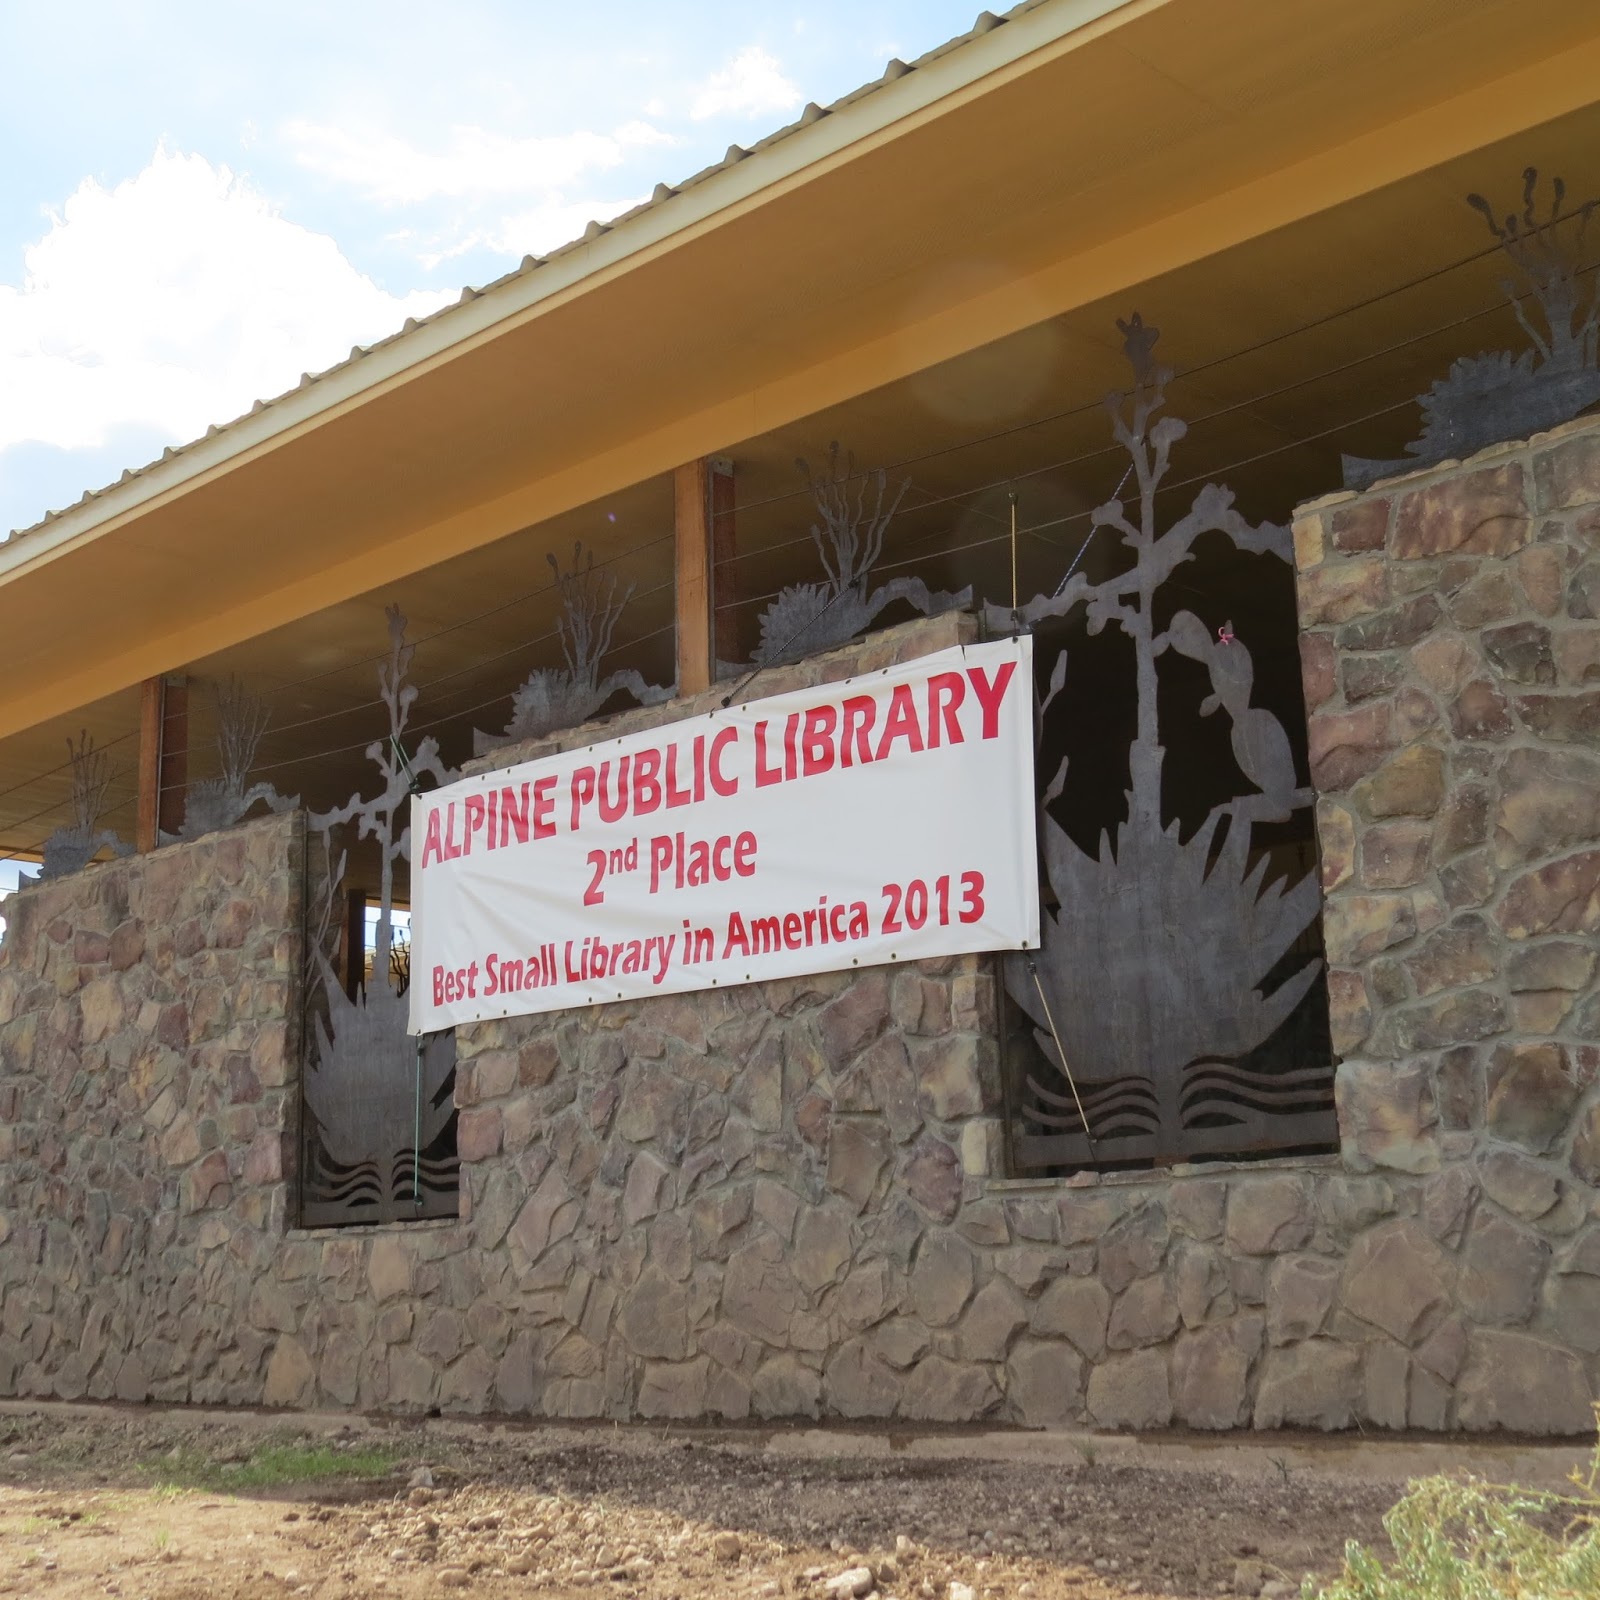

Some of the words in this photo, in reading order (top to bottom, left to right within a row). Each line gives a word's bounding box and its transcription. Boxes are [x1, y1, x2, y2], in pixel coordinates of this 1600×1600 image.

[422, 775, 560, 868] ALPINE
[570, 725, 739, 832] PUBLIC
[754, 661, 1018, 788] LIBRARY
[584, 837, 639, 907] 2nd
[650, 831, 758, 894] Place
[433, 963, 480, 1007] Best
[484, 943, 558, 997] Small
[564, 934, 676, 985] Library
[682, 919, 716, 966] in
[722, 895, 871, 959] America
[881, 870, 986, 935] 2013
